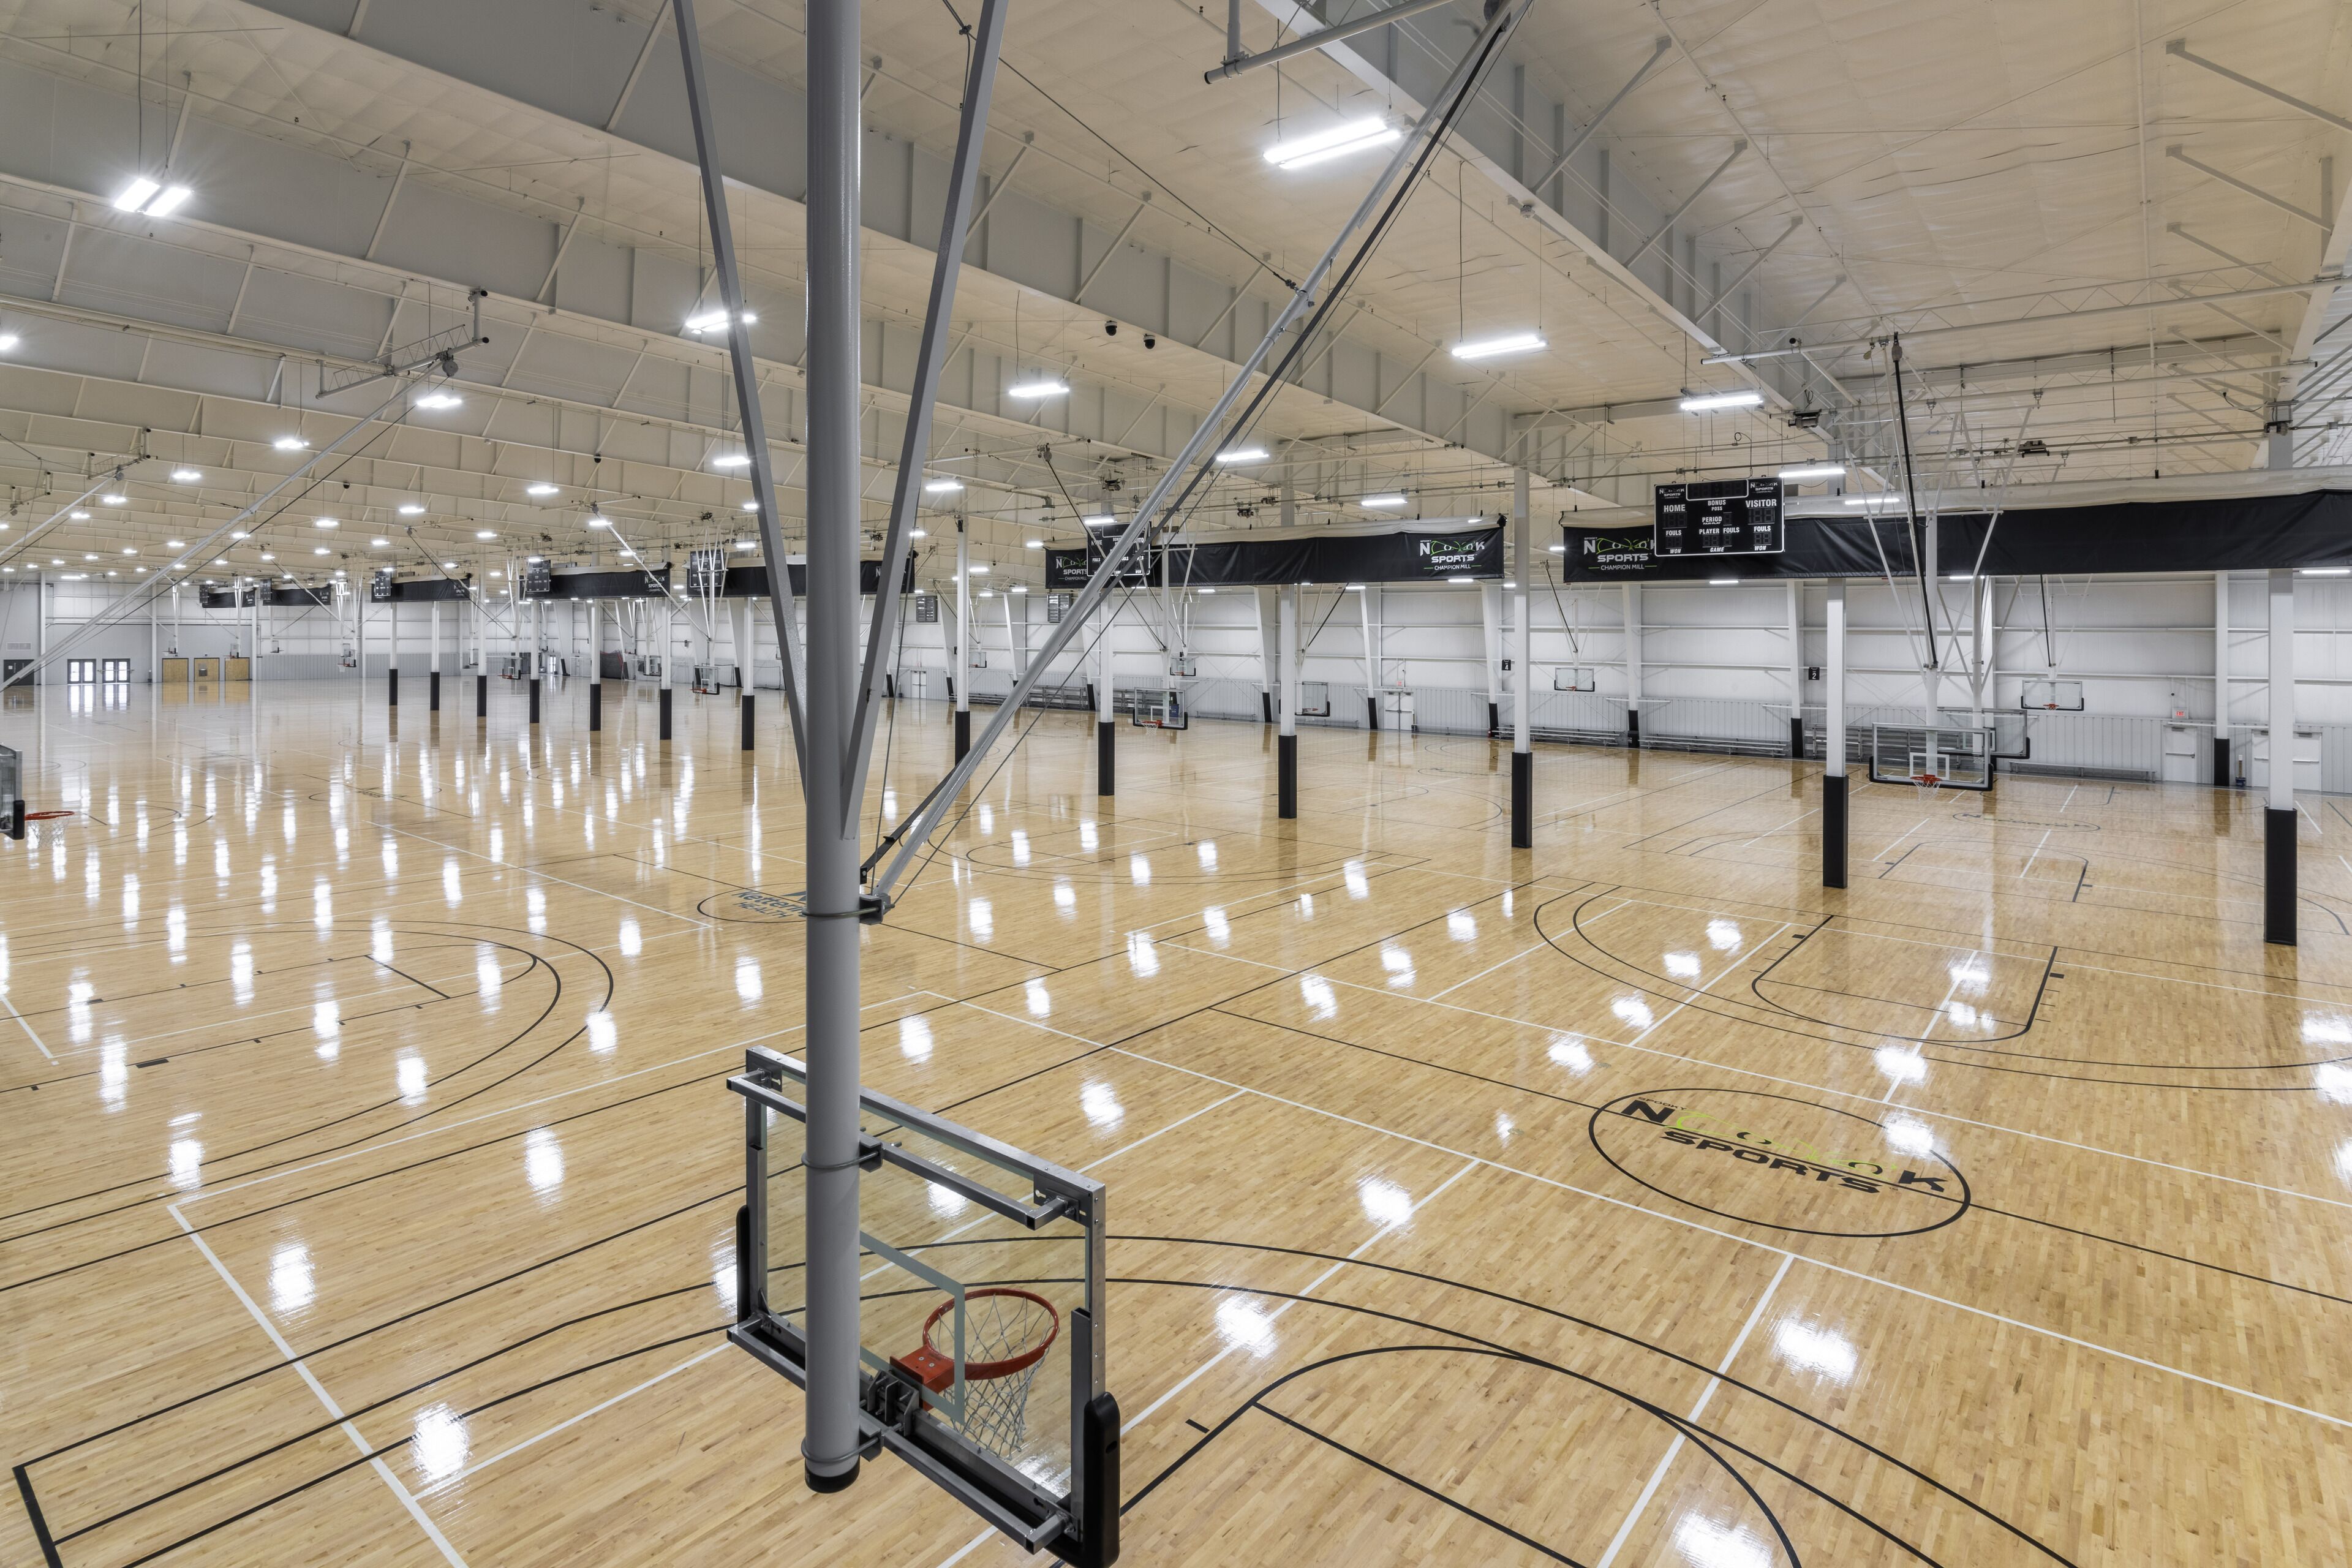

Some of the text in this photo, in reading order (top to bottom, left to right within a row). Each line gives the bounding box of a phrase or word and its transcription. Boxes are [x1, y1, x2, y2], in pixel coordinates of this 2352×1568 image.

[1746, 499, 1777, 508] VISITOR
[1431, 554, 1475, 564] SPORTS
[1597, 553, 1649, 563] SPORTS
[733, 902, 794, 918] HEALTH
[1638, 1096, 1687, 1110] SPOOKY
[1659, 1131, 1883, 1194] SPORTS
